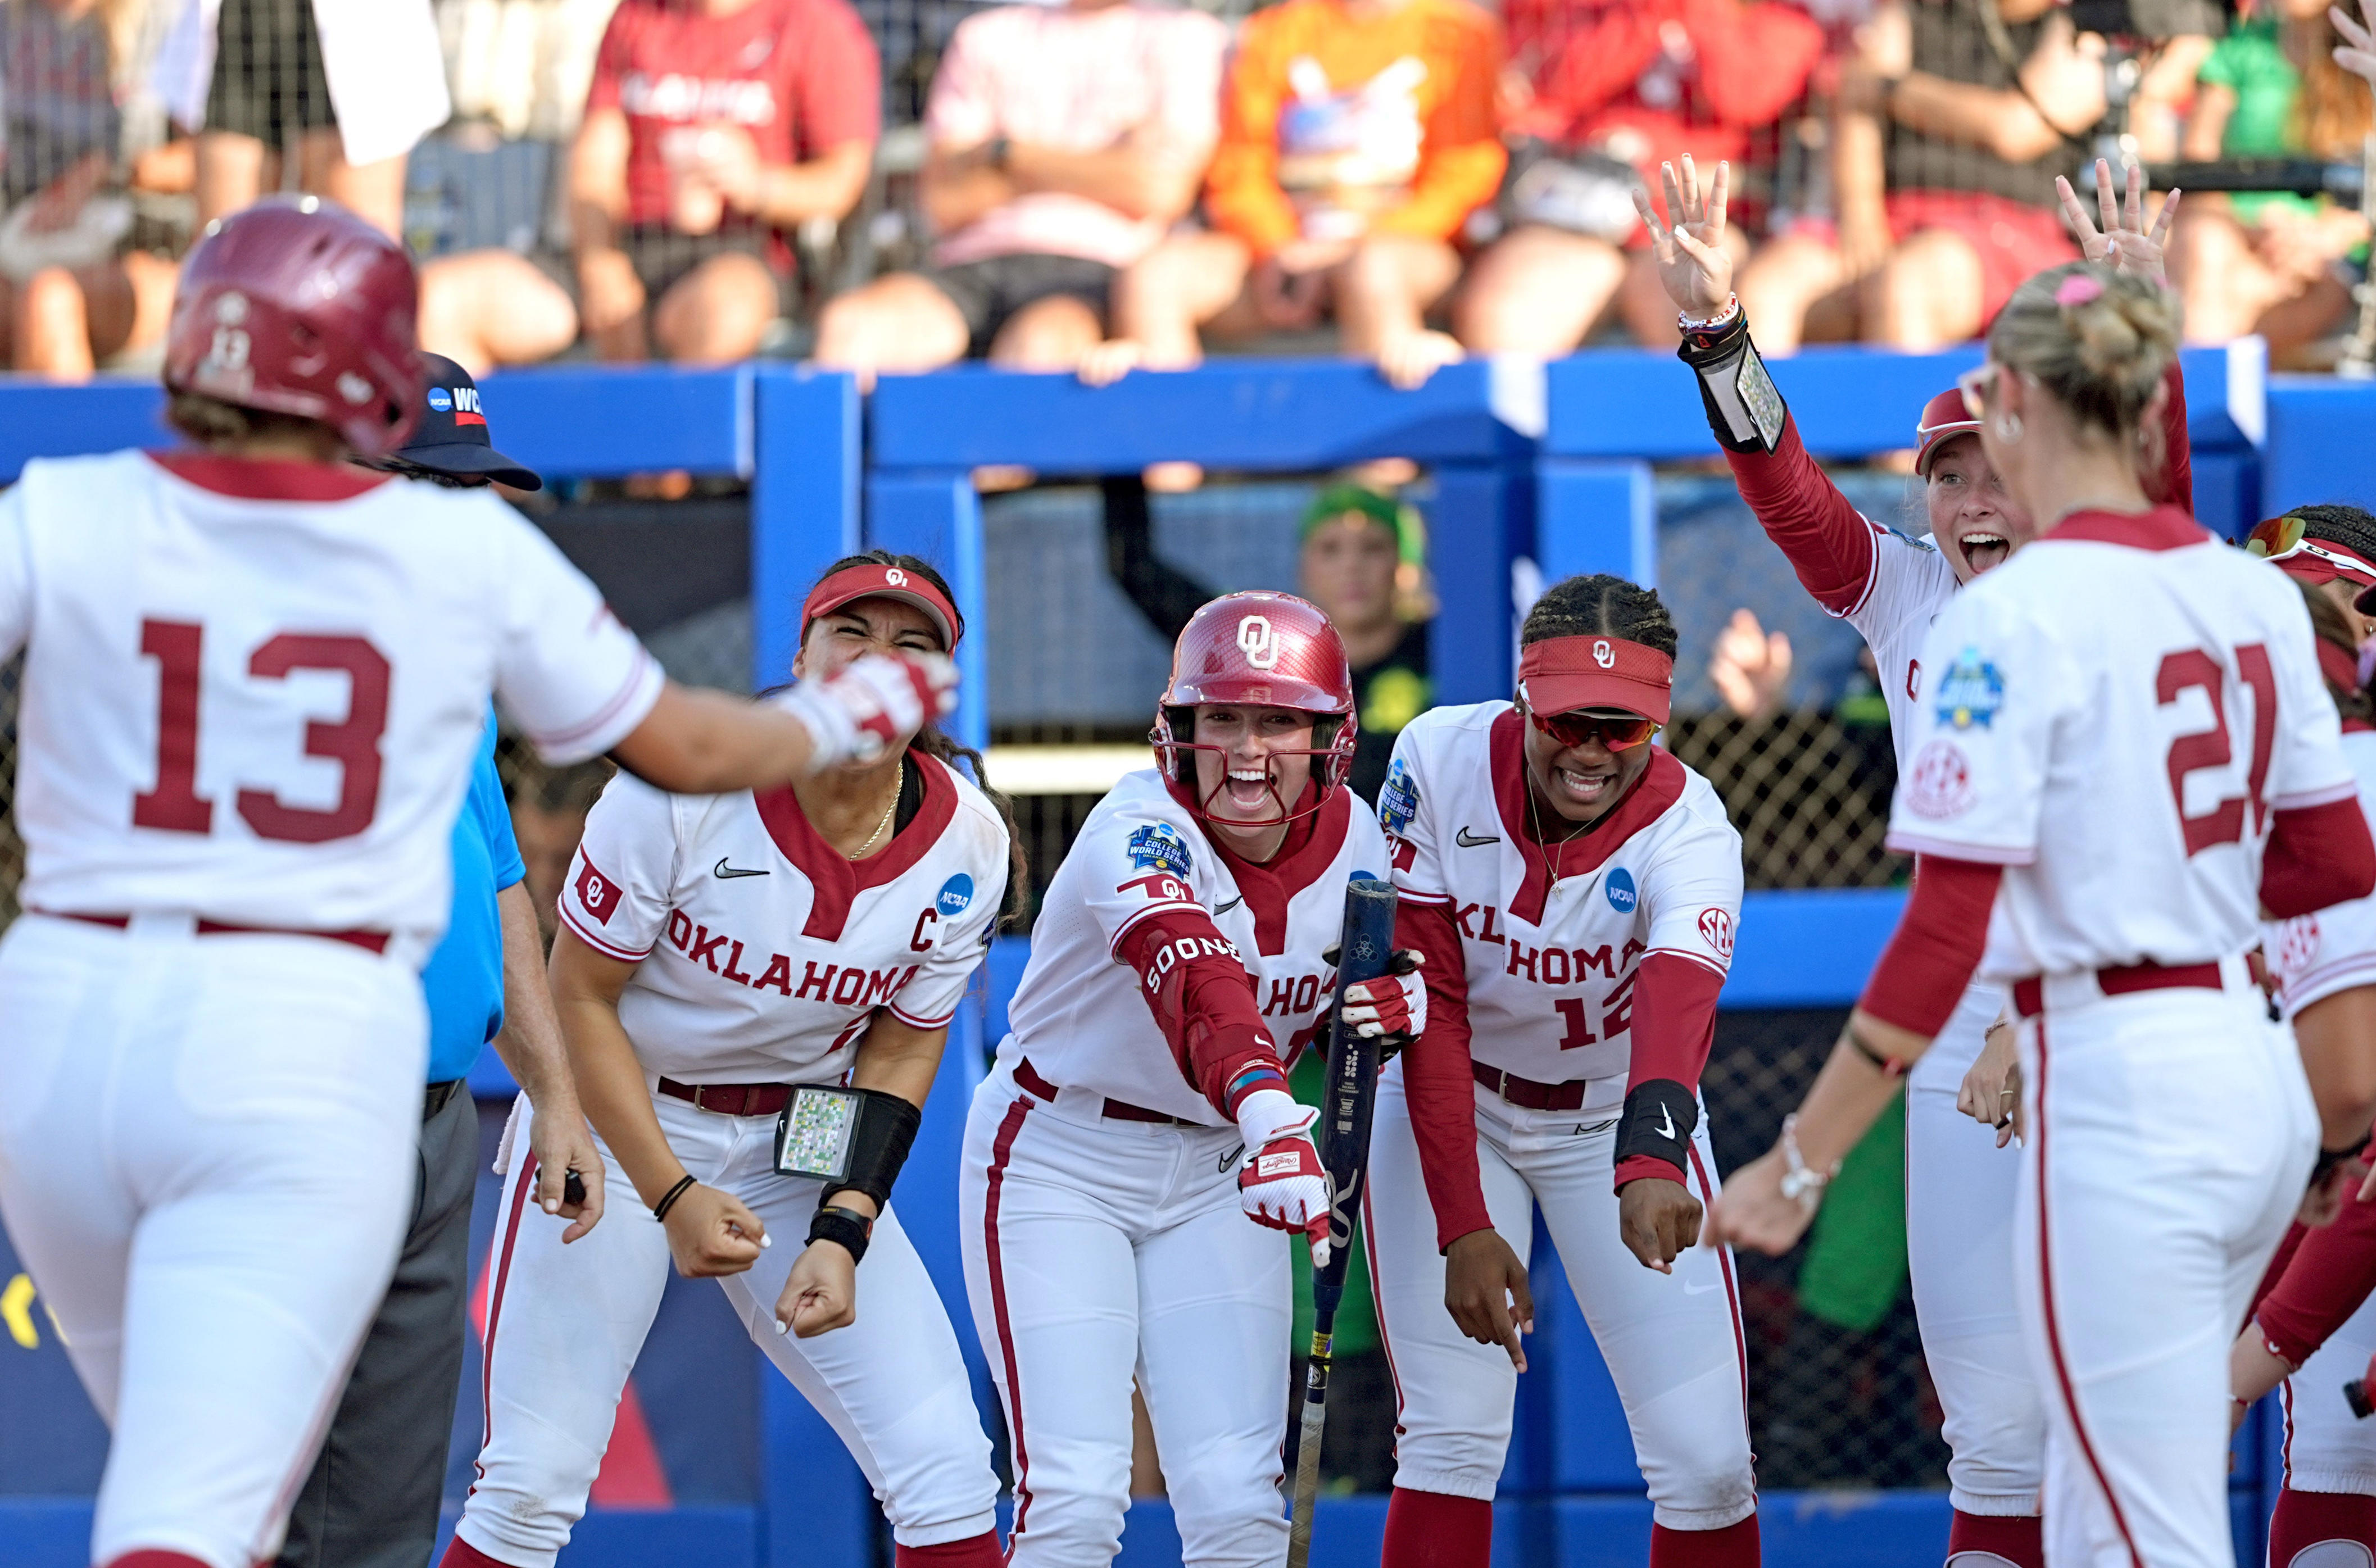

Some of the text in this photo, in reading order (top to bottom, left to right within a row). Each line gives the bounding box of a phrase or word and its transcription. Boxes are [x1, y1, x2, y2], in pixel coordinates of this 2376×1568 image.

[454, 388, 483, 415] WC
[1236, 615, 1280, 670] OU
[1593, 640, 1616, 669] OU
[133, 619, 390, 844] 13
[2156, 642, 2277, 857] 21
[1389, 800, 1414, 818] SERIES
[1130, 846, 1190, 872] WORLD SERIES
[1145, 840, 1182, 858] COLLEGE
[587, 875, 605, 907] OU
[940, 891, 969, 908] NCAA
[1610, 887, 1634, 904] NCAA
[910, 908, 937, 952] C
[1449, 894, 1647, 985] KLHOMA
[1701, 910, 1733, 955] SEC
[669, 908, 919, 1006] OKLAHOMA
[1554, 967, 1639, 1051] 12
